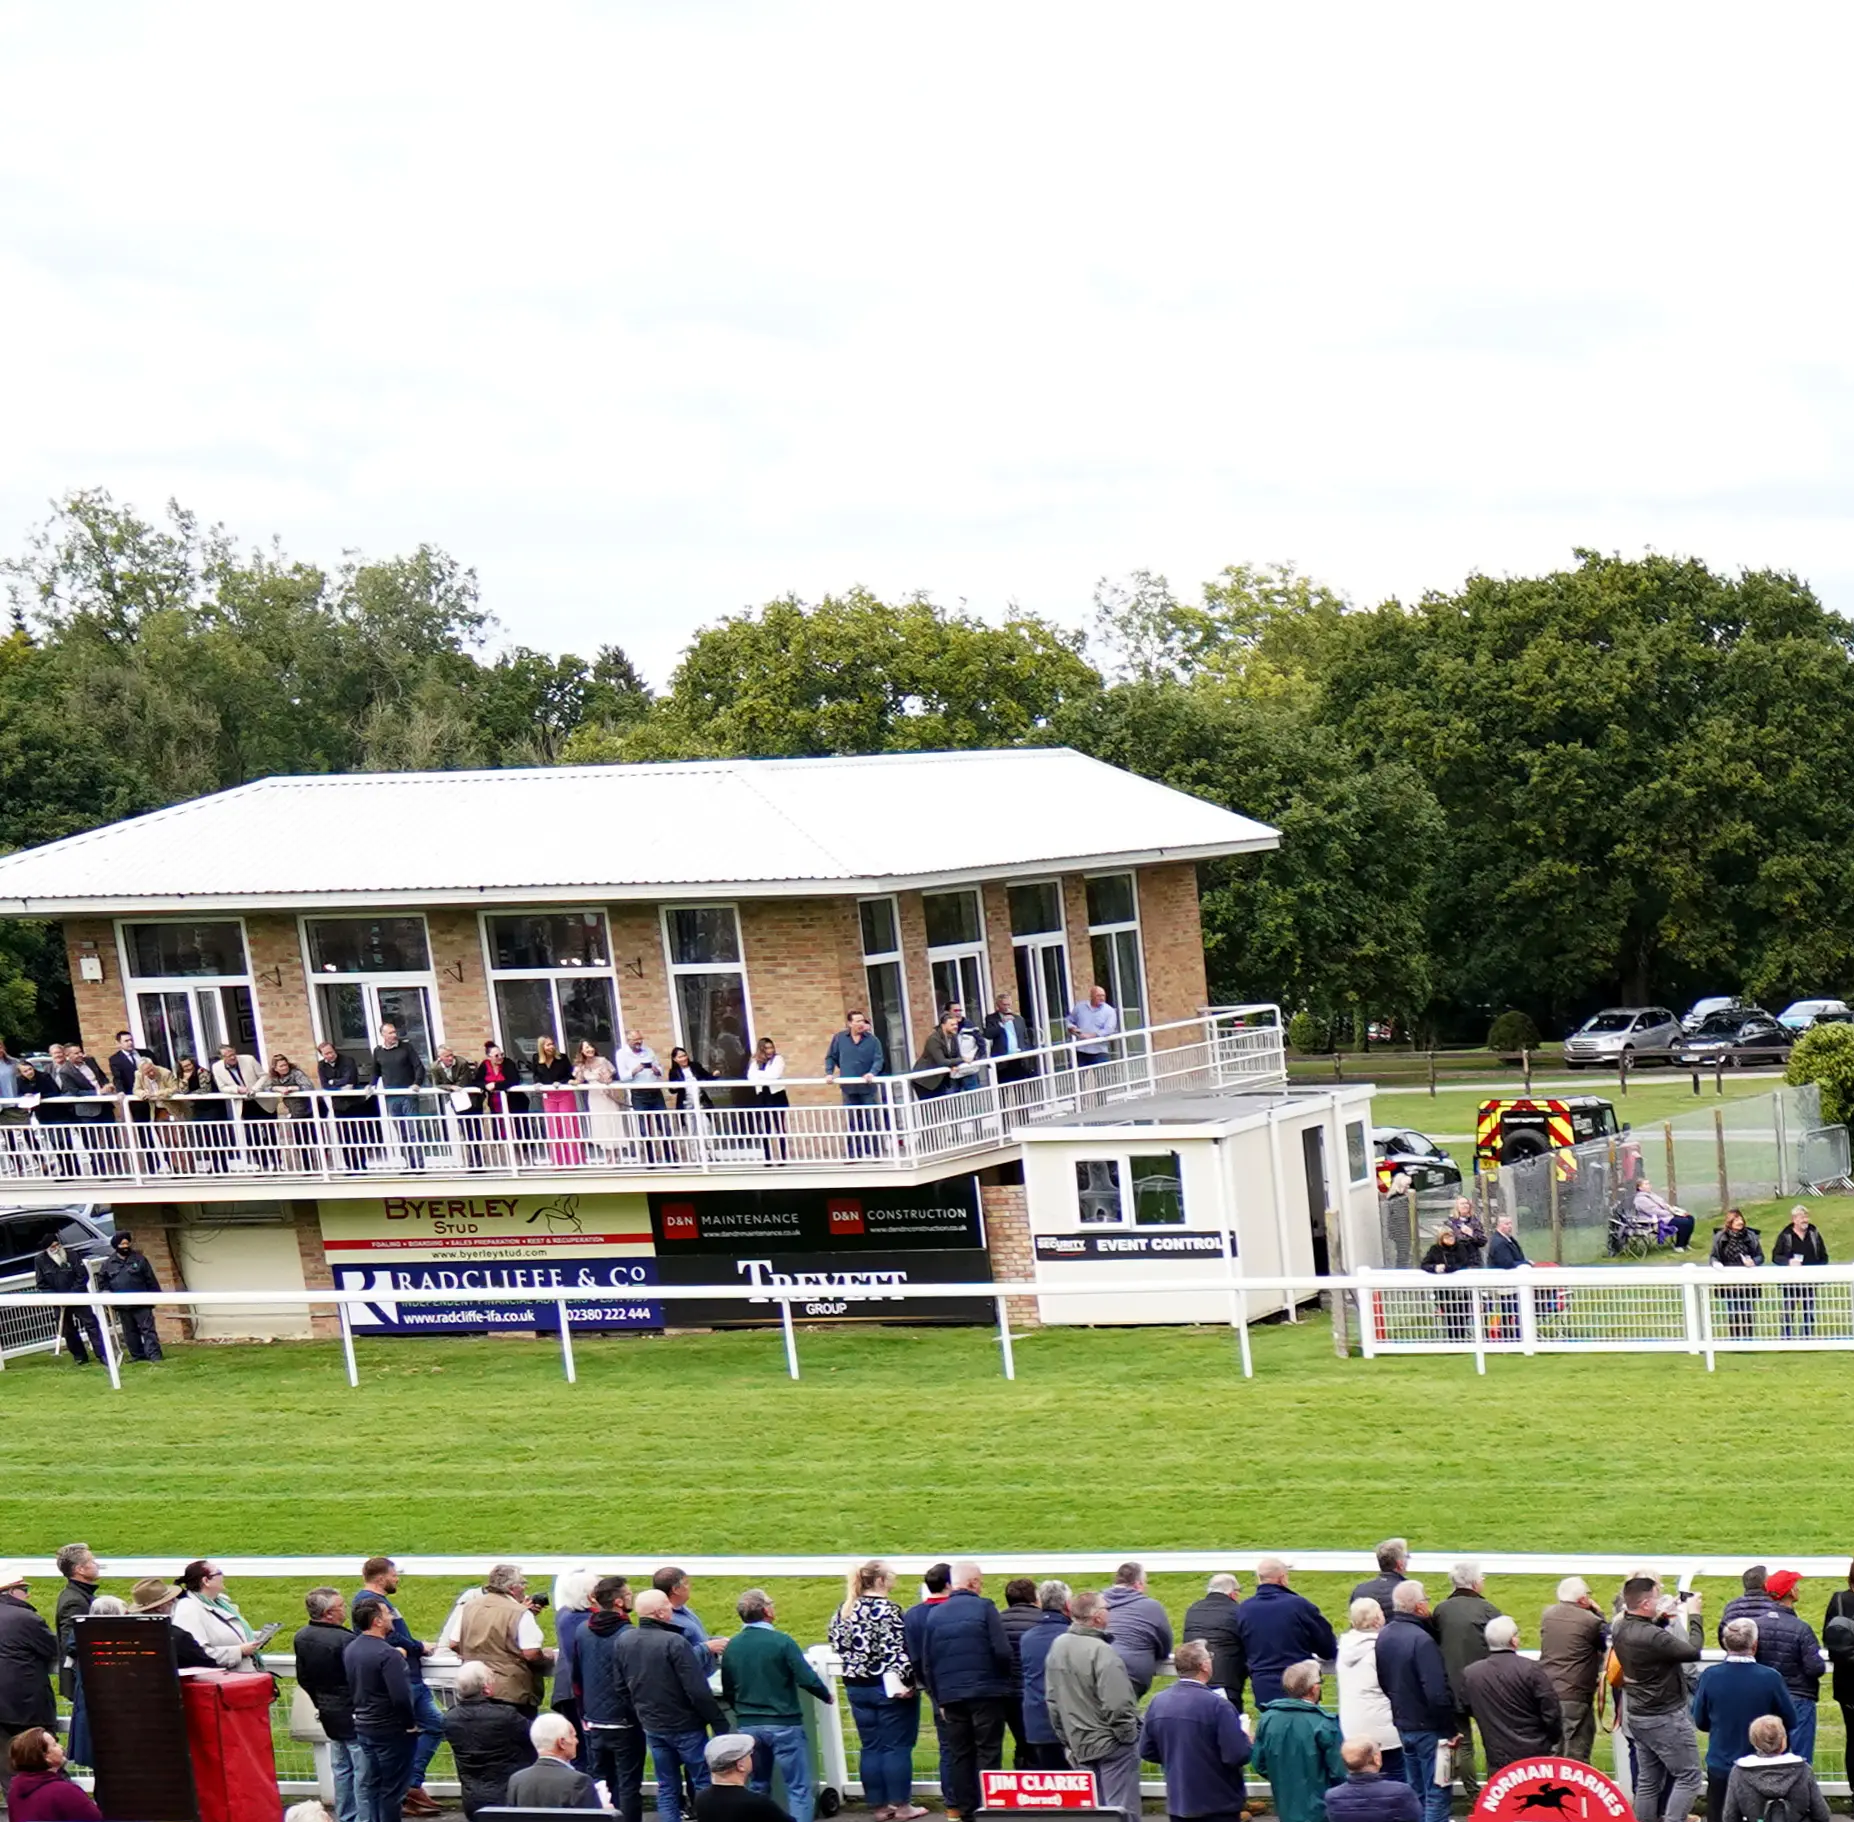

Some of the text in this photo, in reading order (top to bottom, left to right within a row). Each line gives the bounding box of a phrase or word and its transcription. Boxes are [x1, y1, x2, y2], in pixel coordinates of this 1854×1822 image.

[384, 1197, 519, 1220] BYERLEY
[831, 1208, 968, 1222] D&N CONSTRUCTION
[666, 1212, 800, 1227] D&N MAINTENANCE
[1096, 1238, 1149, 1252] EVENT
[1151, 1237, 1224, 1251] CONTROL
[431, 1247, 548, 1260] www.byerleystud.com
[397, 1268, 564, 1290] RADCLIFFE
[578, 1267, 596, 1288] &
[403, 1307, 651, 1324] www.radcliffe-ifa.co.uk 02380 222 444
[806, 1303, 848, 1315] GROUP
[988, 1775, 1090, 1795] JIM CLARKE
[1482, 1764, 1626, 1817] NORMAN BARNES
